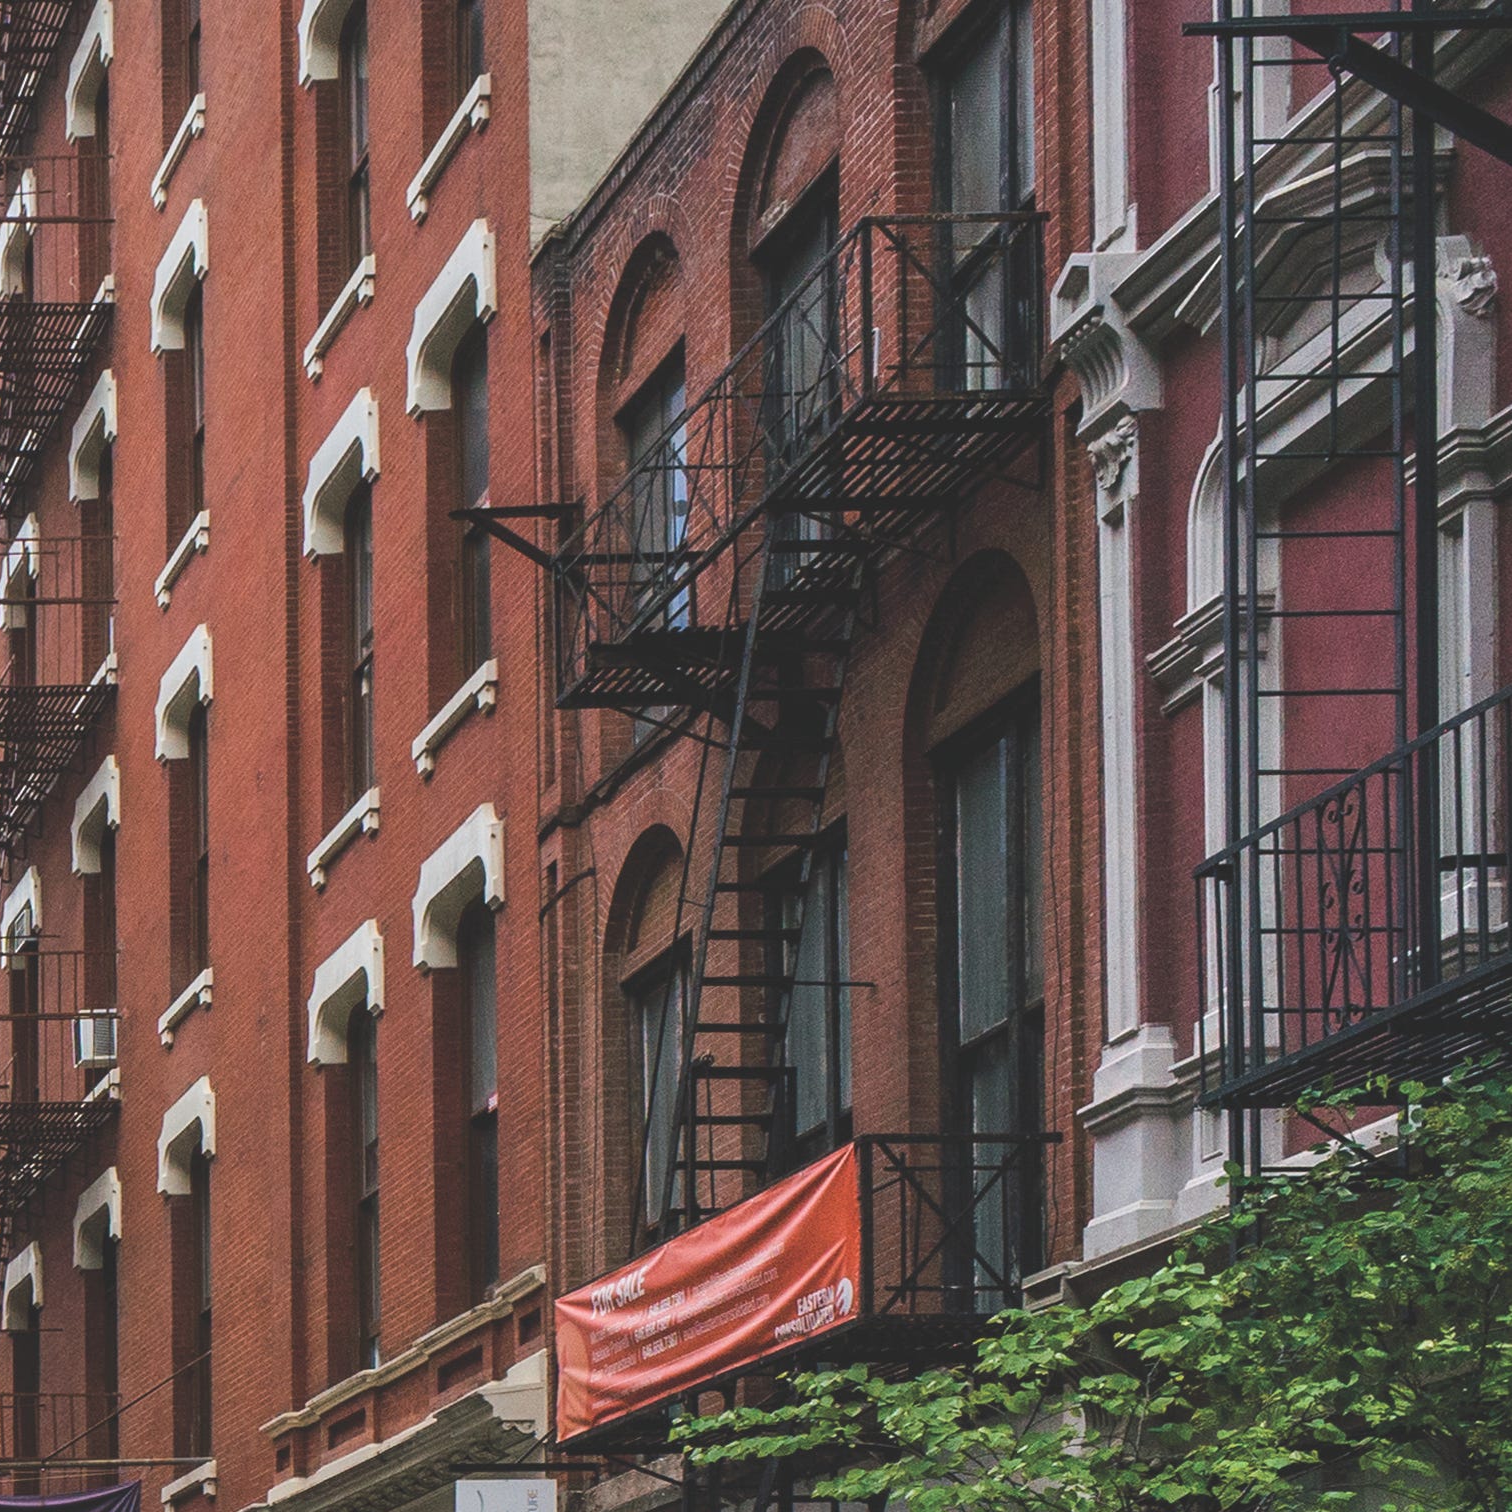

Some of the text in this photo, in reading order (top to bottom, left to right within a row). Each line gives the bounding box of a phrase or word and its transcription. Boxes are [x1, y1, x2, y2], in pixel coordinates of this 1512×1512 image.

[590, 1283, 615, 1320] FOR
[616, 1264, 647, 1307] SALE
[775, 1304, 834, 1342] CONSOLIDATED
